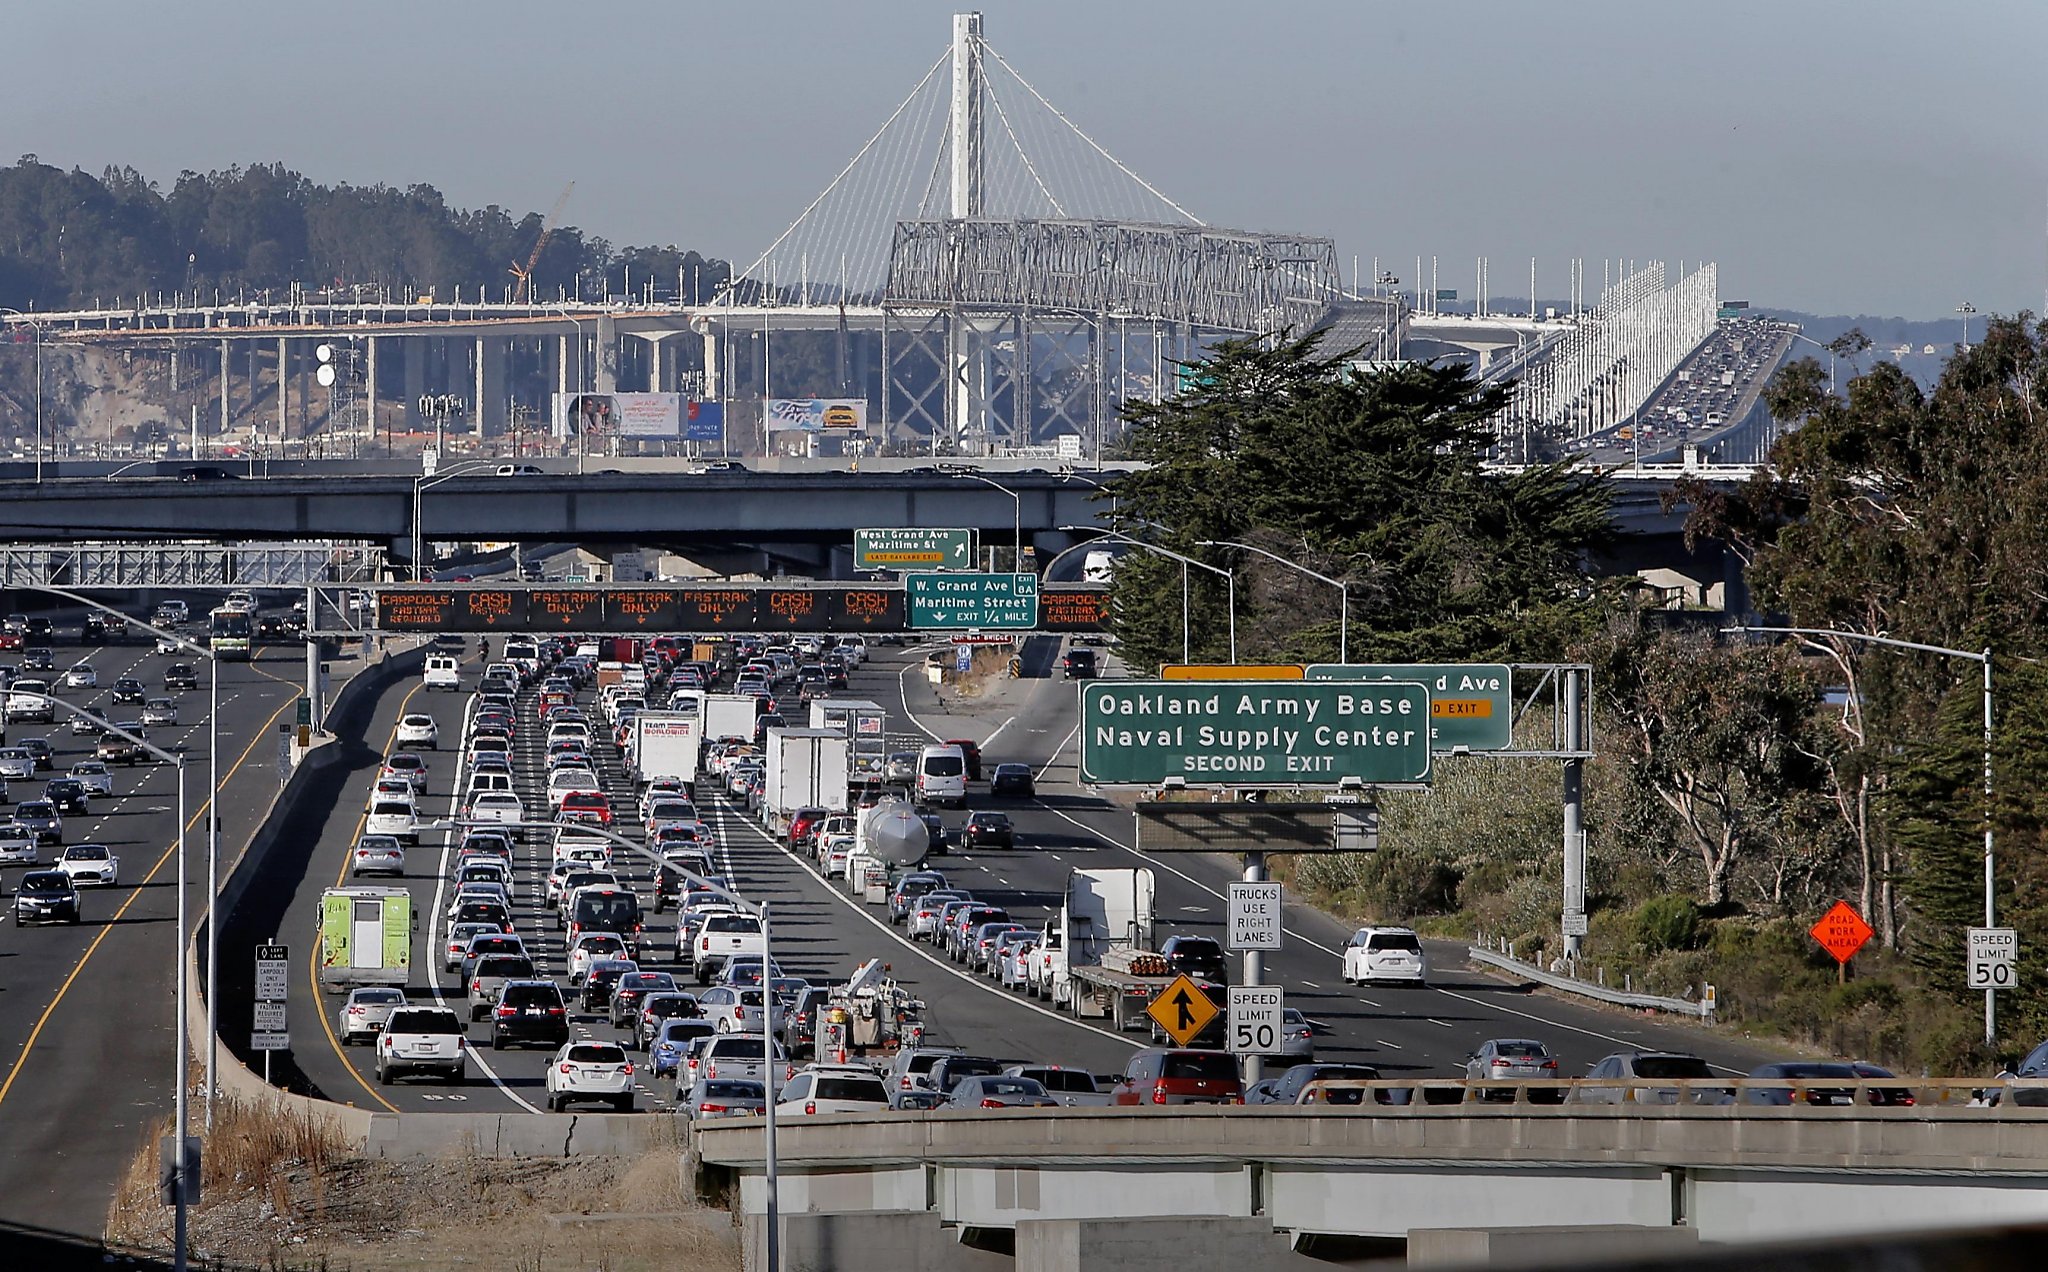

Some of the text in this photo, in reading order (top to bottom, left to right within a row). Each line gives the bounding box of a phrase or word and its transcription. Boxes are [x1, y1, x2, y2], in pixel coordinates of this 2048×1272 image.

[860, 531, 949, 539] West Grand Ave
[869, 541, 936, 550] Maritime St
[916, 581, 1008, 592] W. Grand Ave
[1018, 585, 1033, 594] 8A
[381, 595, 449, 605] CARPOOLS
[469, 592, 512, 608] CASH
[533, 592, 599, 603] FASTRAK
[607, 592, 673, 603] FASTRAK
[684, 592, 750, 603] FASTRAK
[770, 592, 813, 607] CASH
[845, 592, 888, 607] CASH
[915, 597, 1028, 608] Maritime Street
[393, 606, 440, 614] FASTRAK
[547, 603, 584, 613] ONLY
[622, 603, 660, 613] ONLY
[698, 603, 736, 613] ONLY
[390, 615, 441, 623] REQUIRED
[957, 612, 979, 621] EXIT
[1004, 612, 1028, 621] MILE
[1458, 675, 1500, 691] Ave
[1099, 694, 1219, 715] Oakland
[1236, 694, 1321, 723] Army
[1337, 694, 1412, 715] Base
[1448, 703, 1477, 714] EXIT
[1096, 726, 1183, 746] Naval
[1198, 725, 1300, 754] Supply
[1314, 725, 1416, 746] Center
[1184, 755, 1334, 772] SECOND EXIT
[1233, 889, 1277, 900] TRUCKS
[1243, 904, 1266, 914] USE
[1237, 918, 1272, 928] RIGHT
[1829, 915, 1854, 924] ROAD
[1236, 932, 1274, 942] LANES
[1829, 928, 1855, 936] WORK
[1827, 939, 1859, 947] AHEAD
[1972, 935, 2013, 945] SPEED
[1977, 950, 2008, 959] LIMIT
[1976, 963, 2009, 984] 50
[1233, 994, 1278, 1005] SPEED
[1238, 1010, 1272, 1021] LIMIT
[1237, 1024, 1274, 1048] 50
